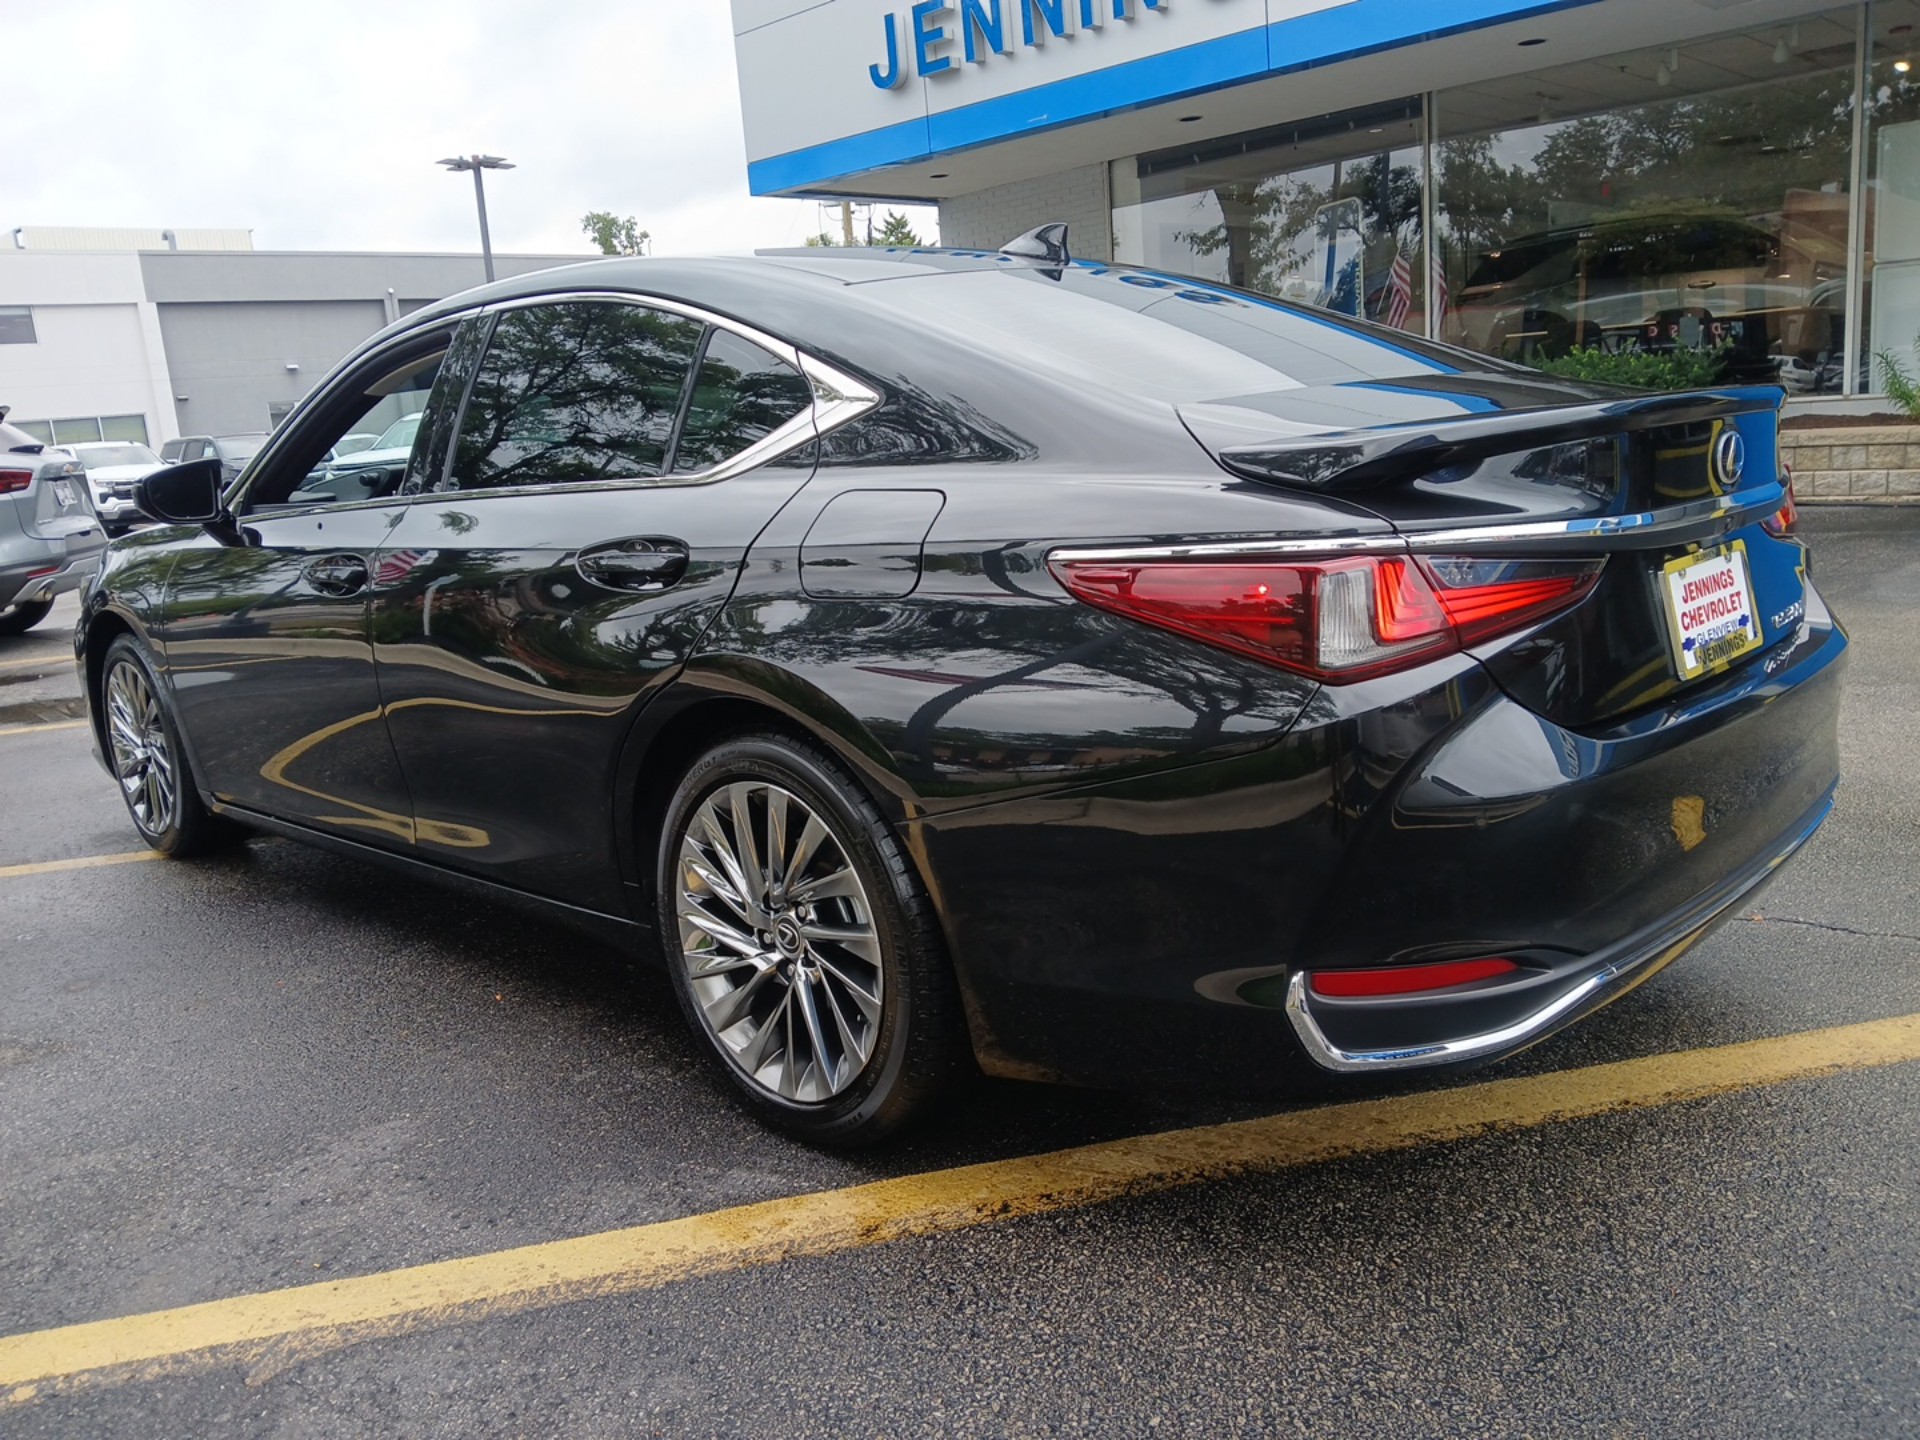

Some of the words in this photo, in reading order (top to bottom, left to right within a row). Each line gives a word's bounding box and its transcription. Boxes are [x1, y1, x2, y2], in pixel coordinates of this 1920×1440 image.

[868, 0, 1167, 89] JENN
[1682, 568, 1734, 604] JENNINGS
[1681, 590, 1742, 631] CHEVROLET
[1696, 619, 1739, 645] GLENVIEW
[1703, 633, 1745, 665] JENNINGS
